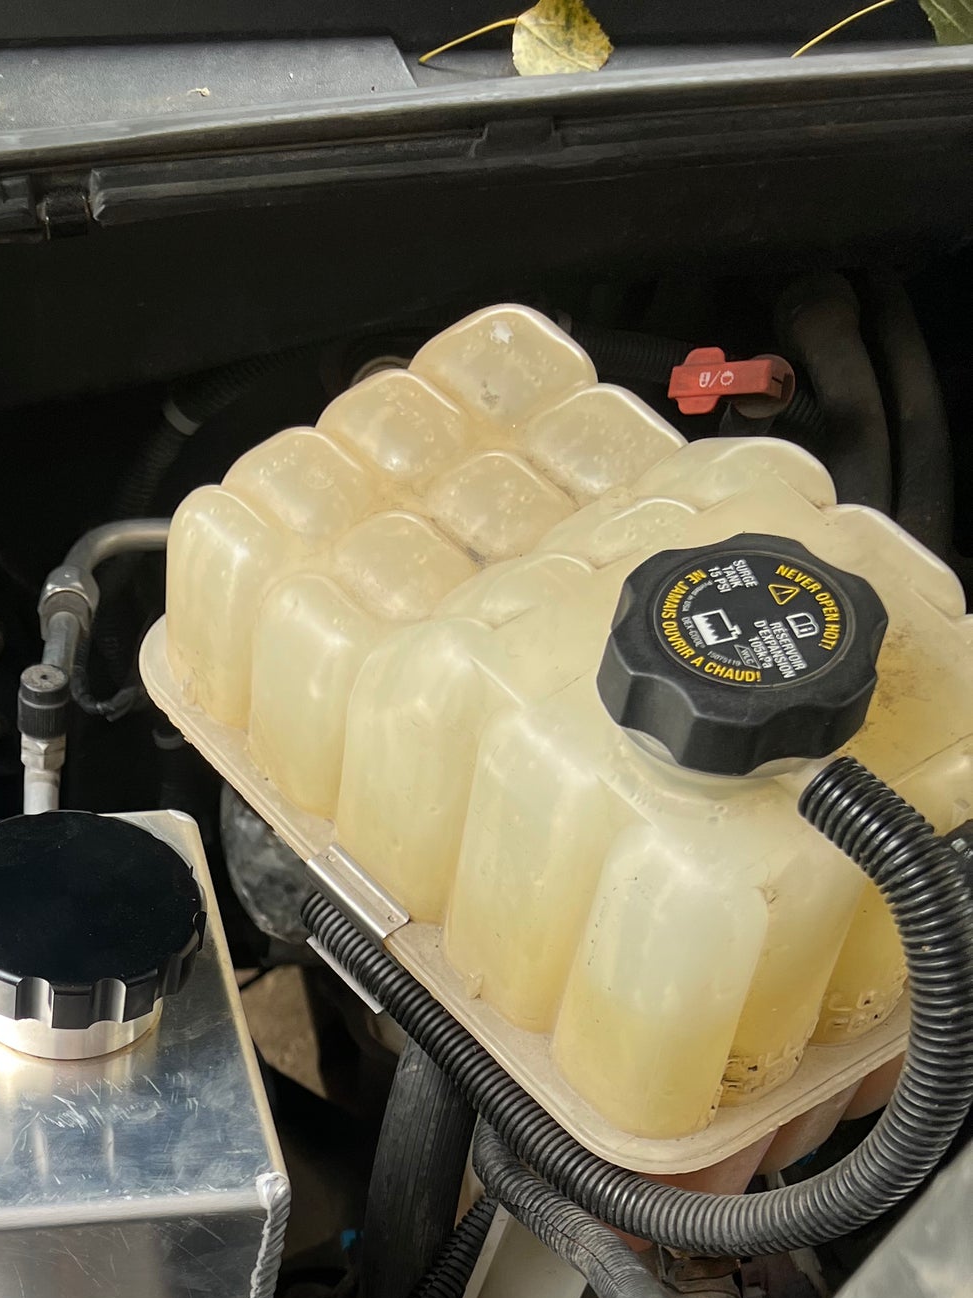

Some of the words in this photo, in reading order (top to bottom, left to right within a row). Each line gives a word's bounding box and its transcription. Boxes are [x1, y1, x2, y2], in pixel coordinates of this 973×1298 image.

[684, 568, 707, 585] NE
[708, 565, 723, 579] 15
[714, 577, 733, 593] PSI
[721, 565, 744, 589] TANK
[732, 559, 759, 588] SURGE
[775, 564, 822, 593] NEVER
[661, 580, 690, 619] JAMAIS
[815, 592, 841, 621] OPEN
[661, 621, 696, 659] OUVRIR
[753, 620, 797, 679] D'EXPANSION
[818, 623, 841, 651] HOT!
[690, 655, 705, 667] A
[748, 636, 774, 669] 105kPa
[704, 661, 762, 682] CHAUD!
